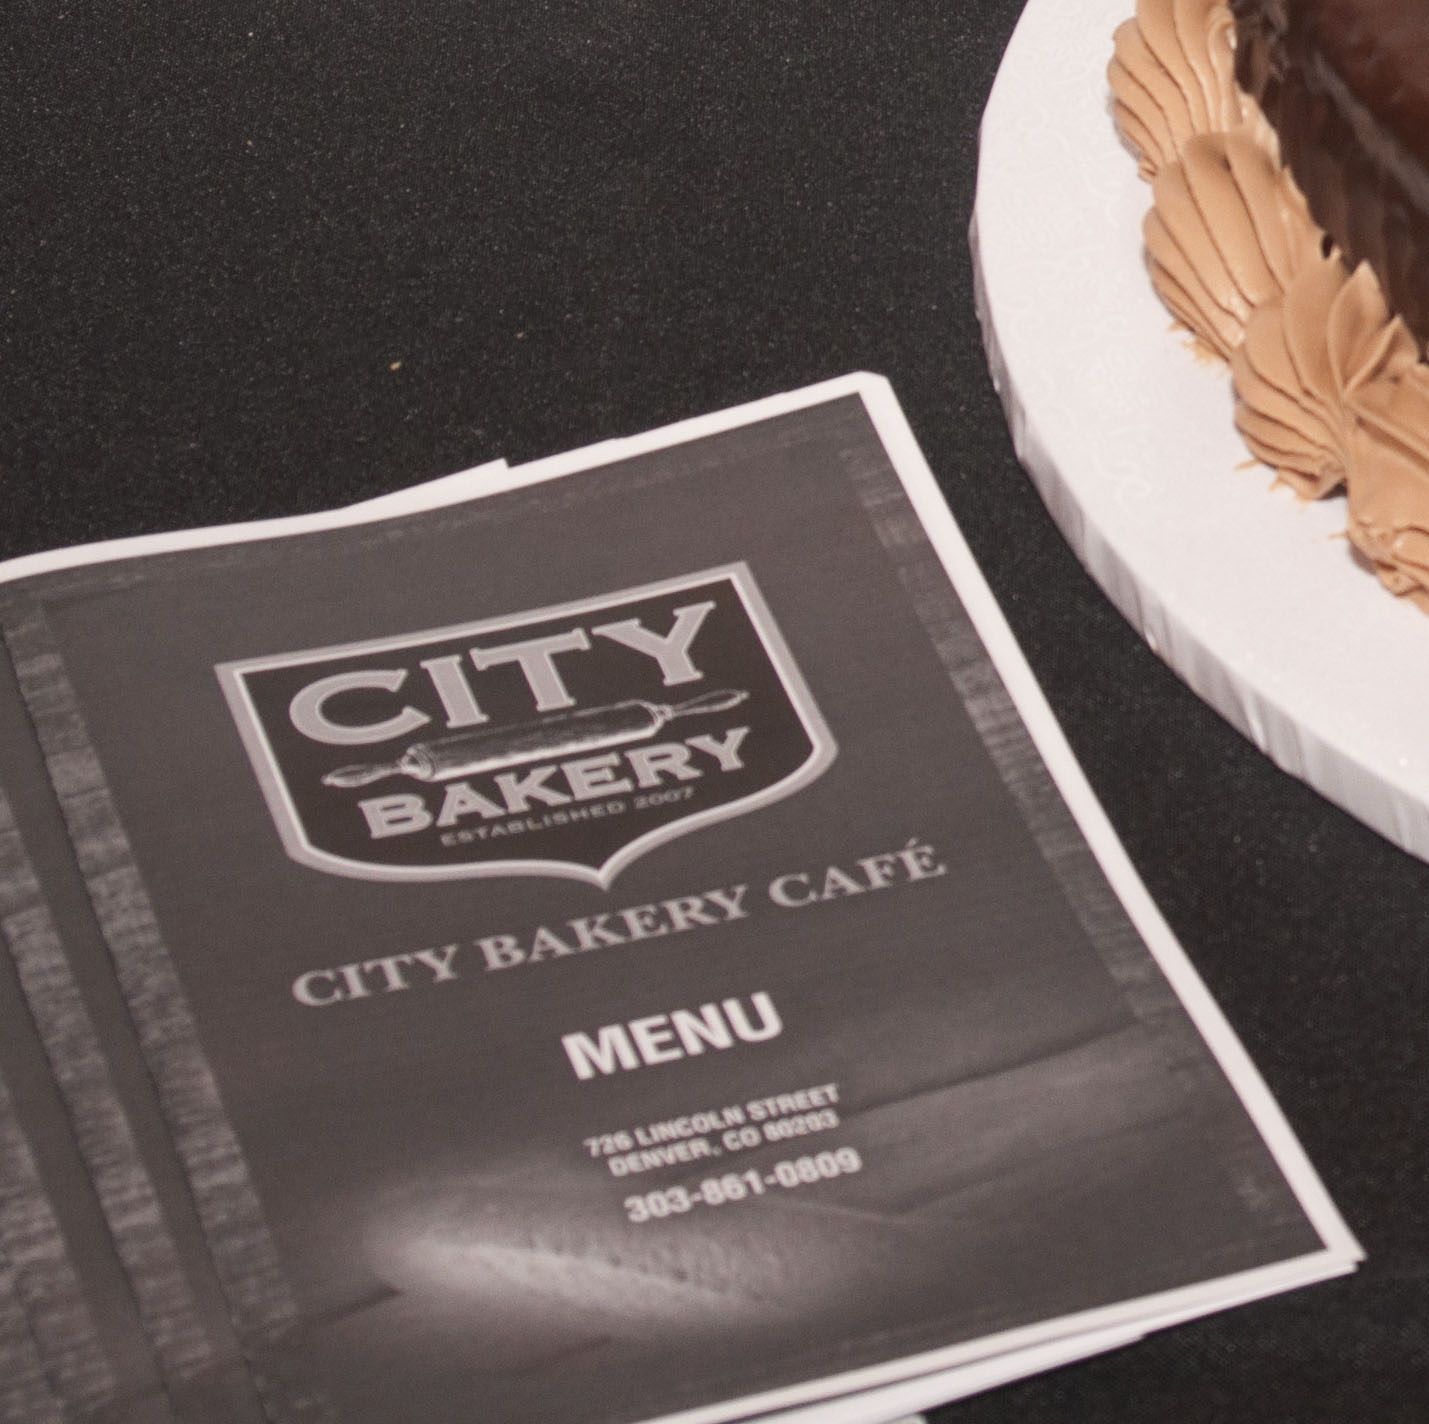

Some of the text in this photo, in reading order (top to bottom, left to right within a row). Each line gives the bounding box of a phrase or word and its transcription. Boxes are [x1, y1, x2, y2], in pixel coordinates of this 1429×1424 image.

[288, 600, 716, 745] CITY
[358, 726, 751, 839] BAKERY
[440, 785, 694, 847] ESTABLISHED 2007
[291, 837, 947, 1007] CITY BAKERY CAFÉ
[561, 990, 783, 1081] MENU
[583, 1083, 840, 1157] 726 LINCOLN STREET
[608, 1137, 722, 1177] DENVER,
[722, 1125, 762, 1152] CO
[624, 1147, 862, 1223] 303-861-0809
